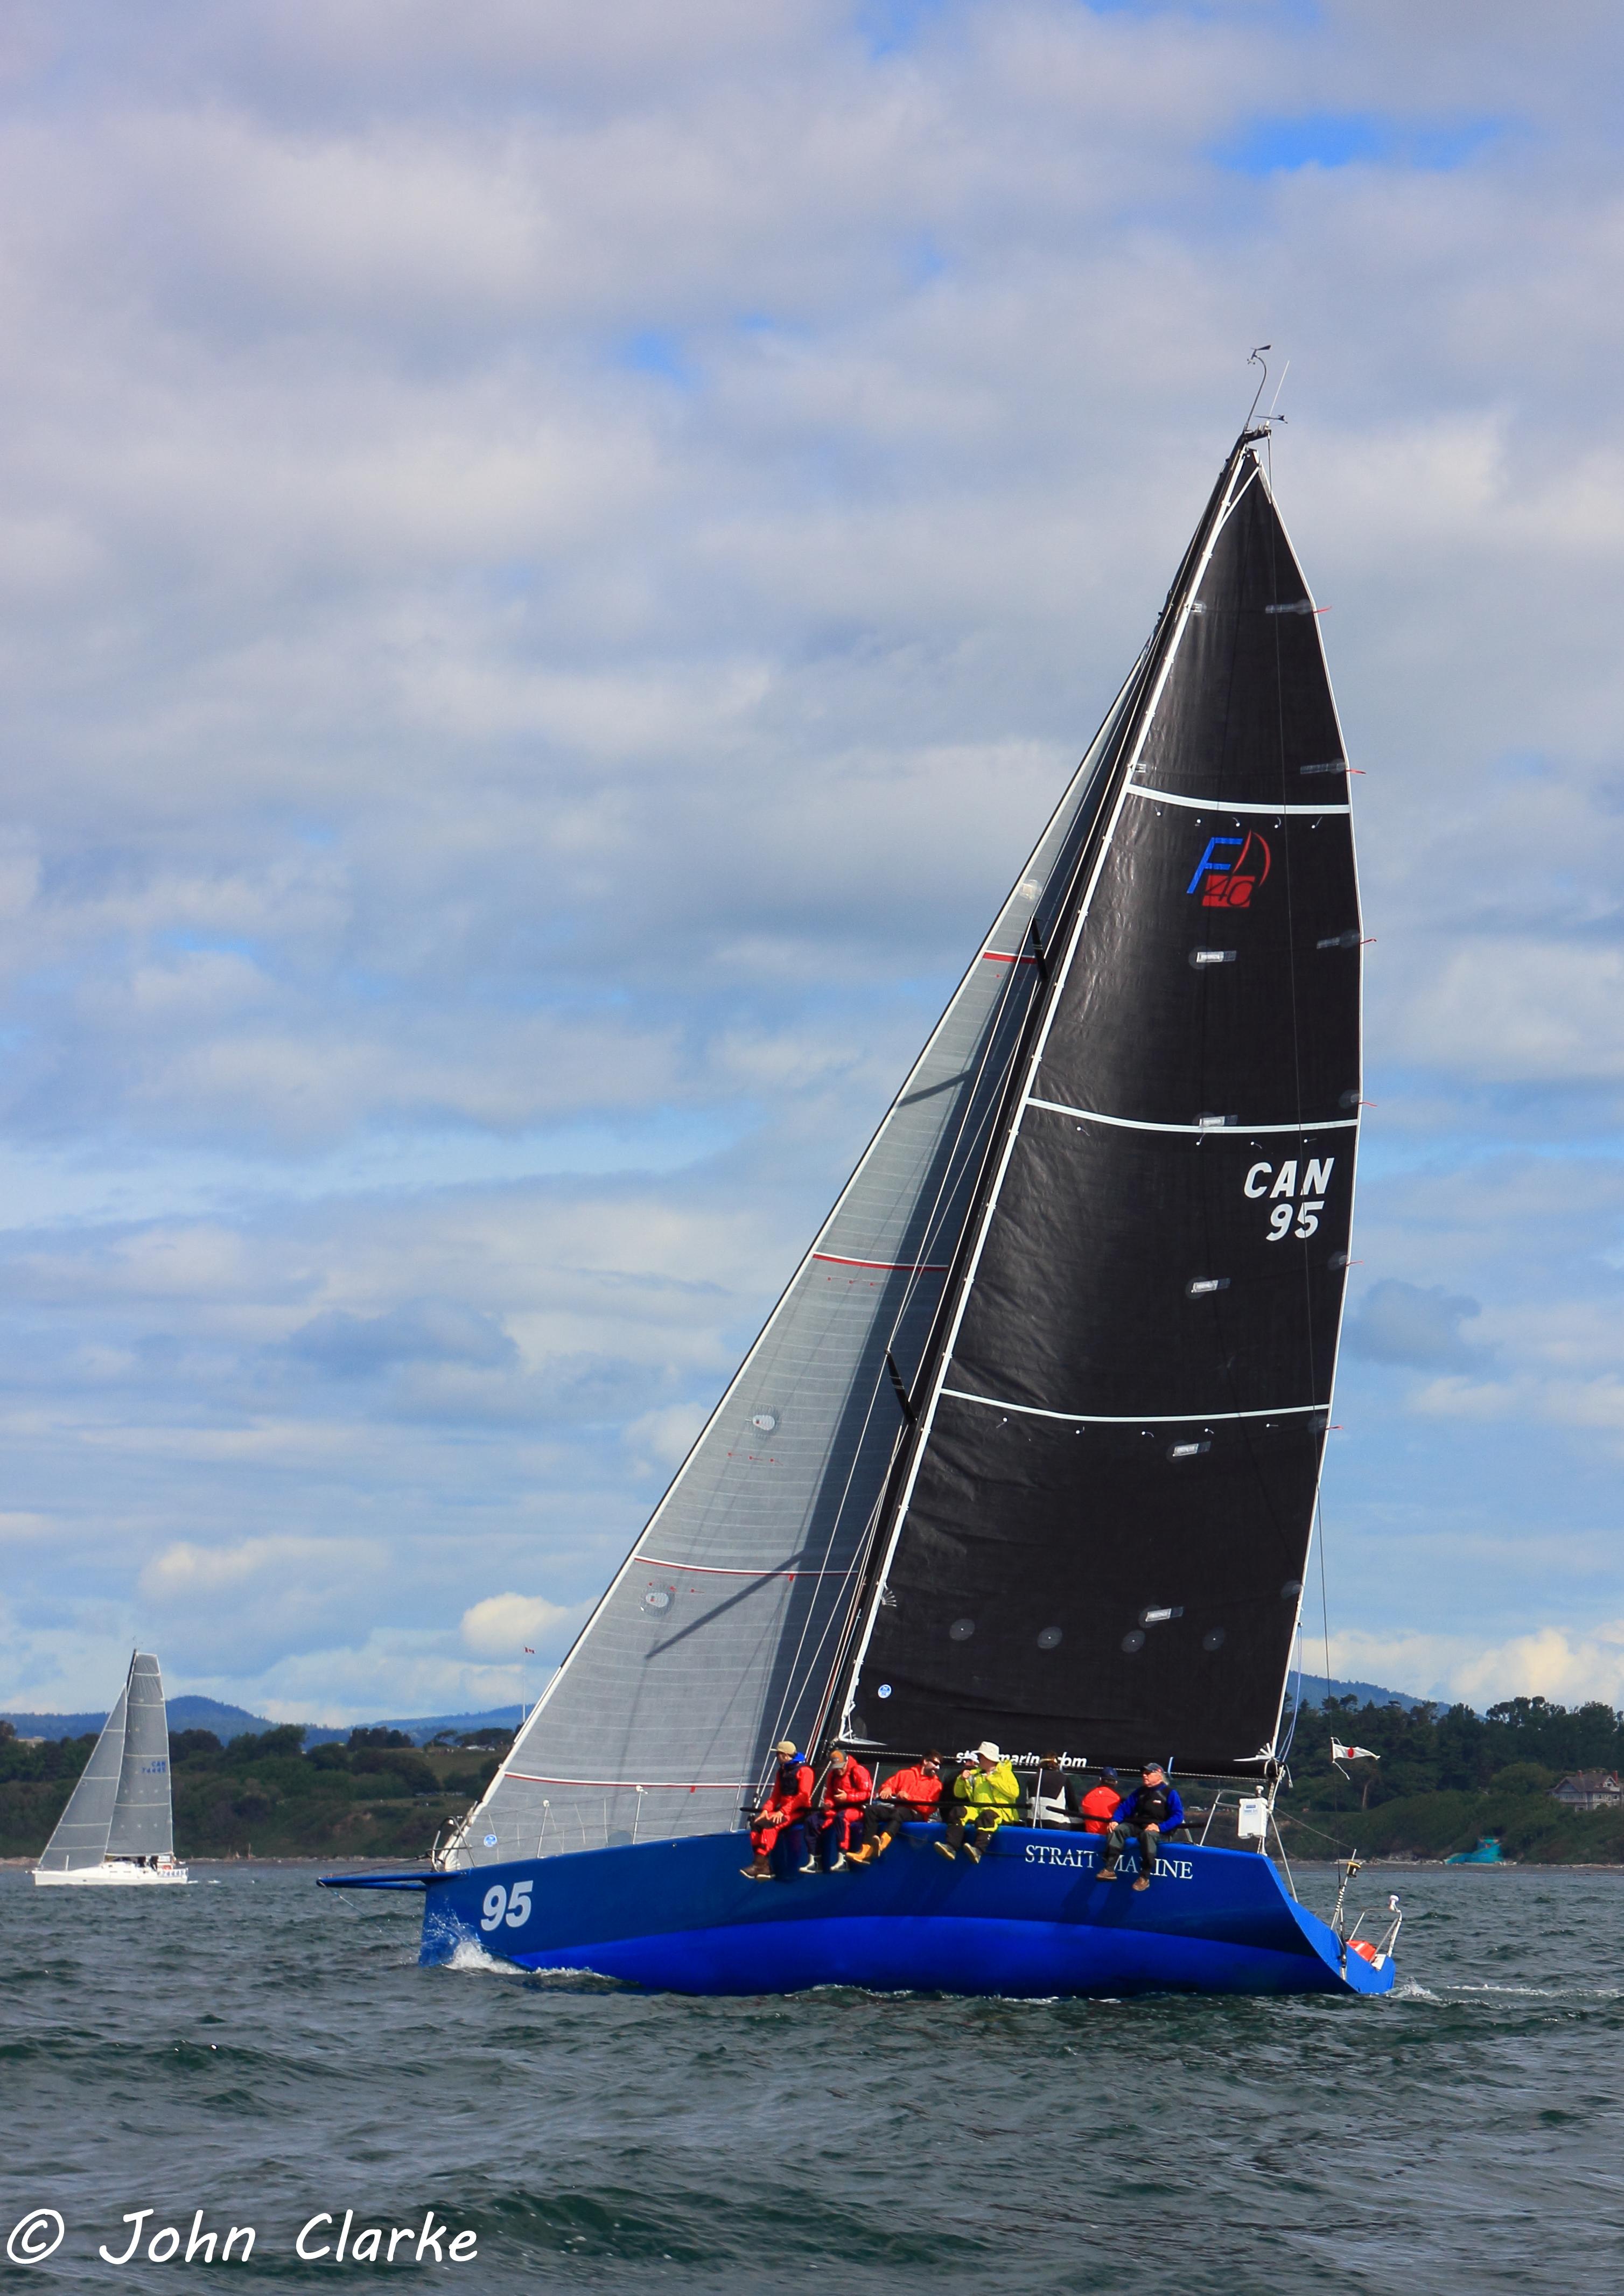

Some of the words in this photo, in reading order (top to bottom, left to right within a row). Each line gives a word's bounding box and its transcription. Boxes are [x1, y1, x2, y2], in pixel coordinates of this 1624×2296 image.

[1244, 1157, 1335, 1199] CAN
[1265, 1200, 1325, 1242] 95
[1025, 1844, 1099, 1868] STRAIT
[1113, 1854, 1193, 1879] MAINE
[480, 1880, 534, 1931] 95
